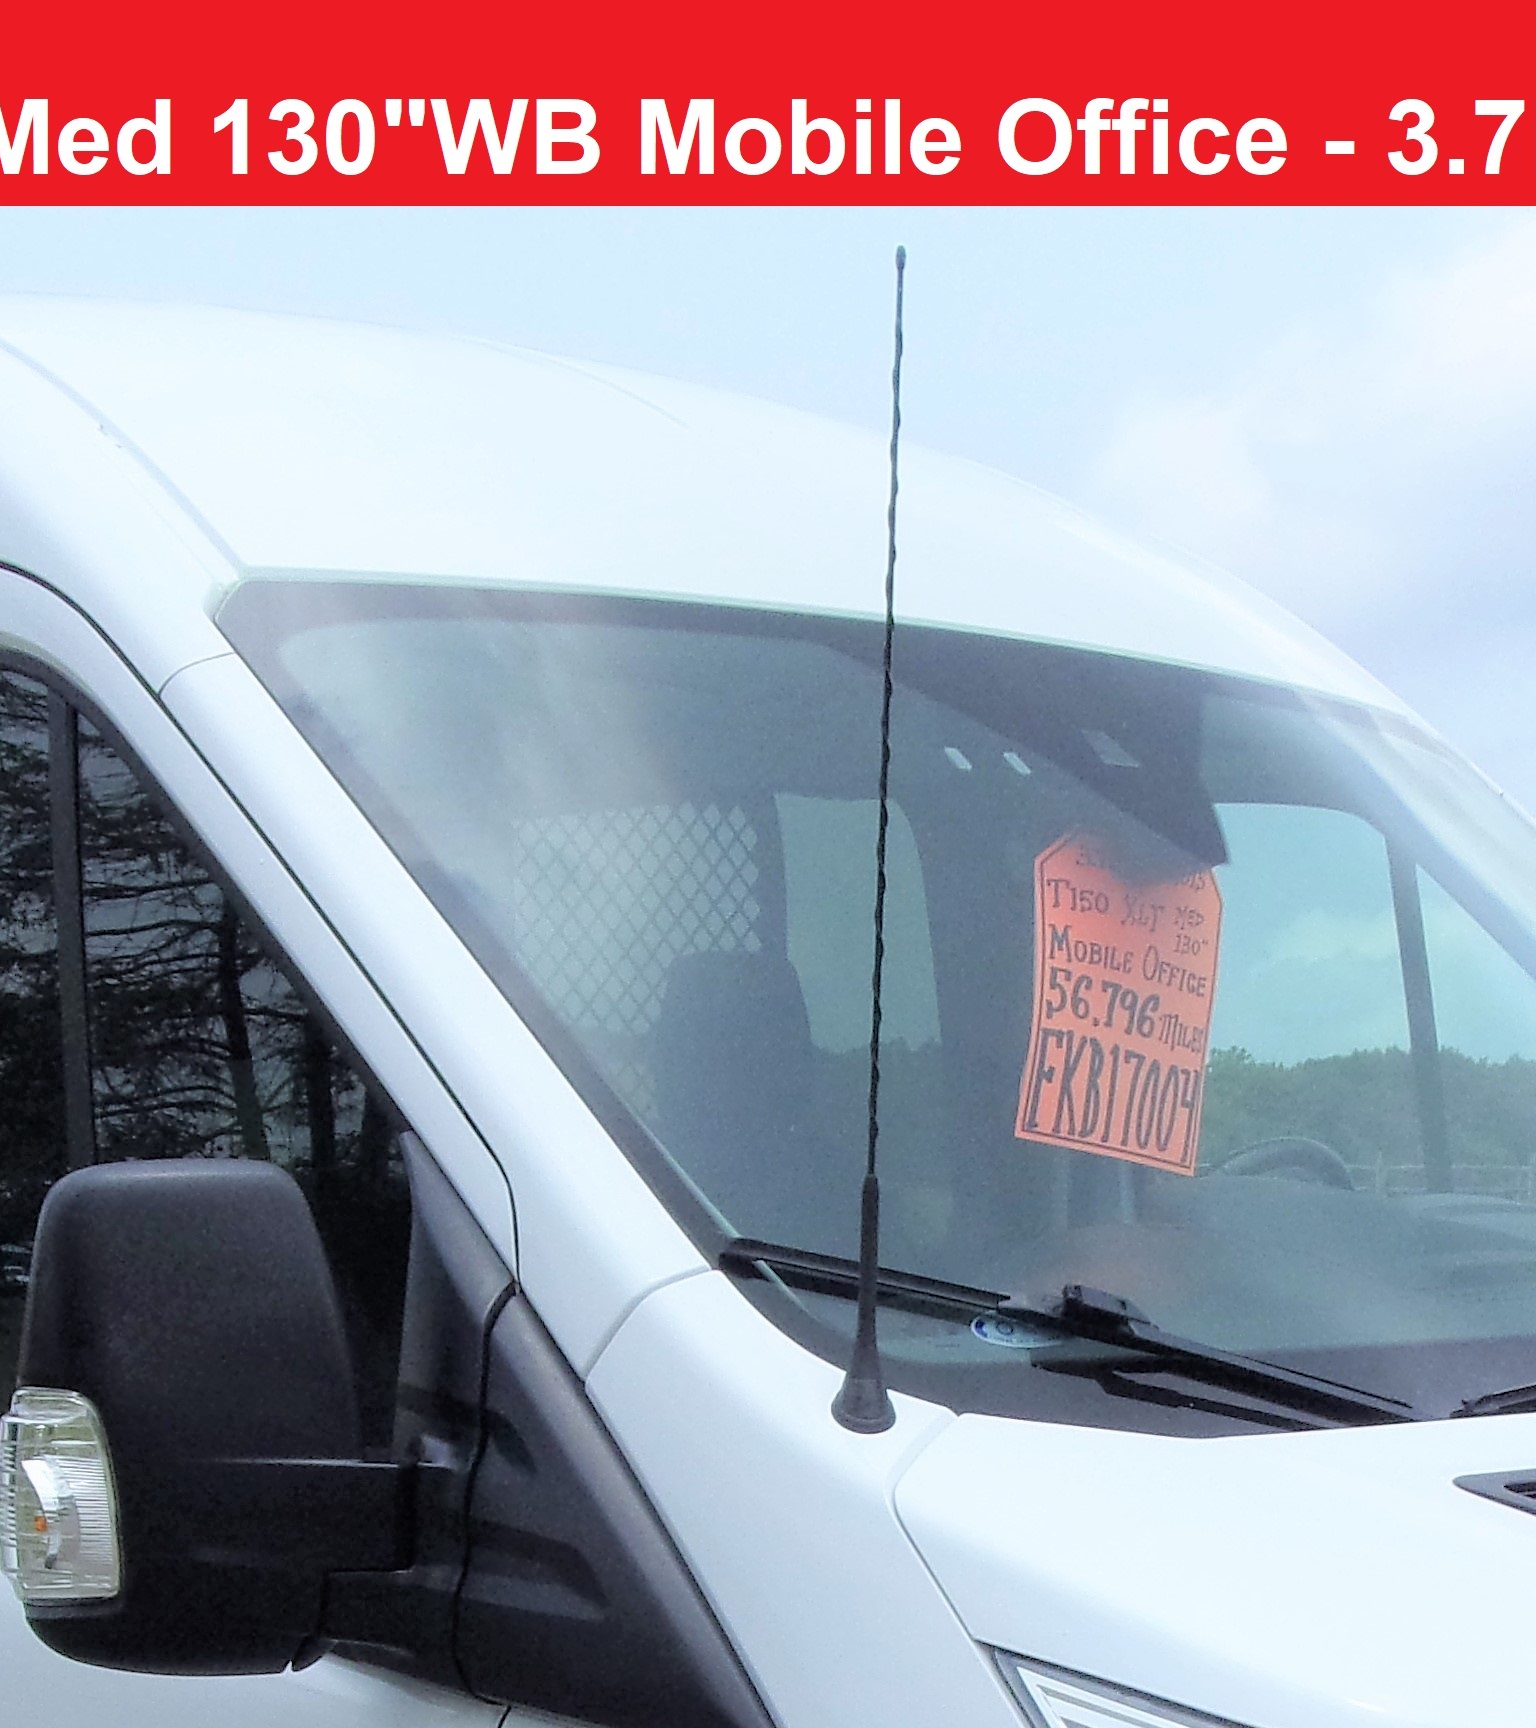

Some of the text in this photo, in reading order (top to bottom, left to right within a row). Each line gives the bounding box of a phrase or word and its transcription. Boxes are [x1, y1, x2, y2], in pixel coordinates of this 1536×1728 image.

[1046, 878, 1110, 914] T150
[1048, 923, 1208, 998] MOBILE OFFICE
